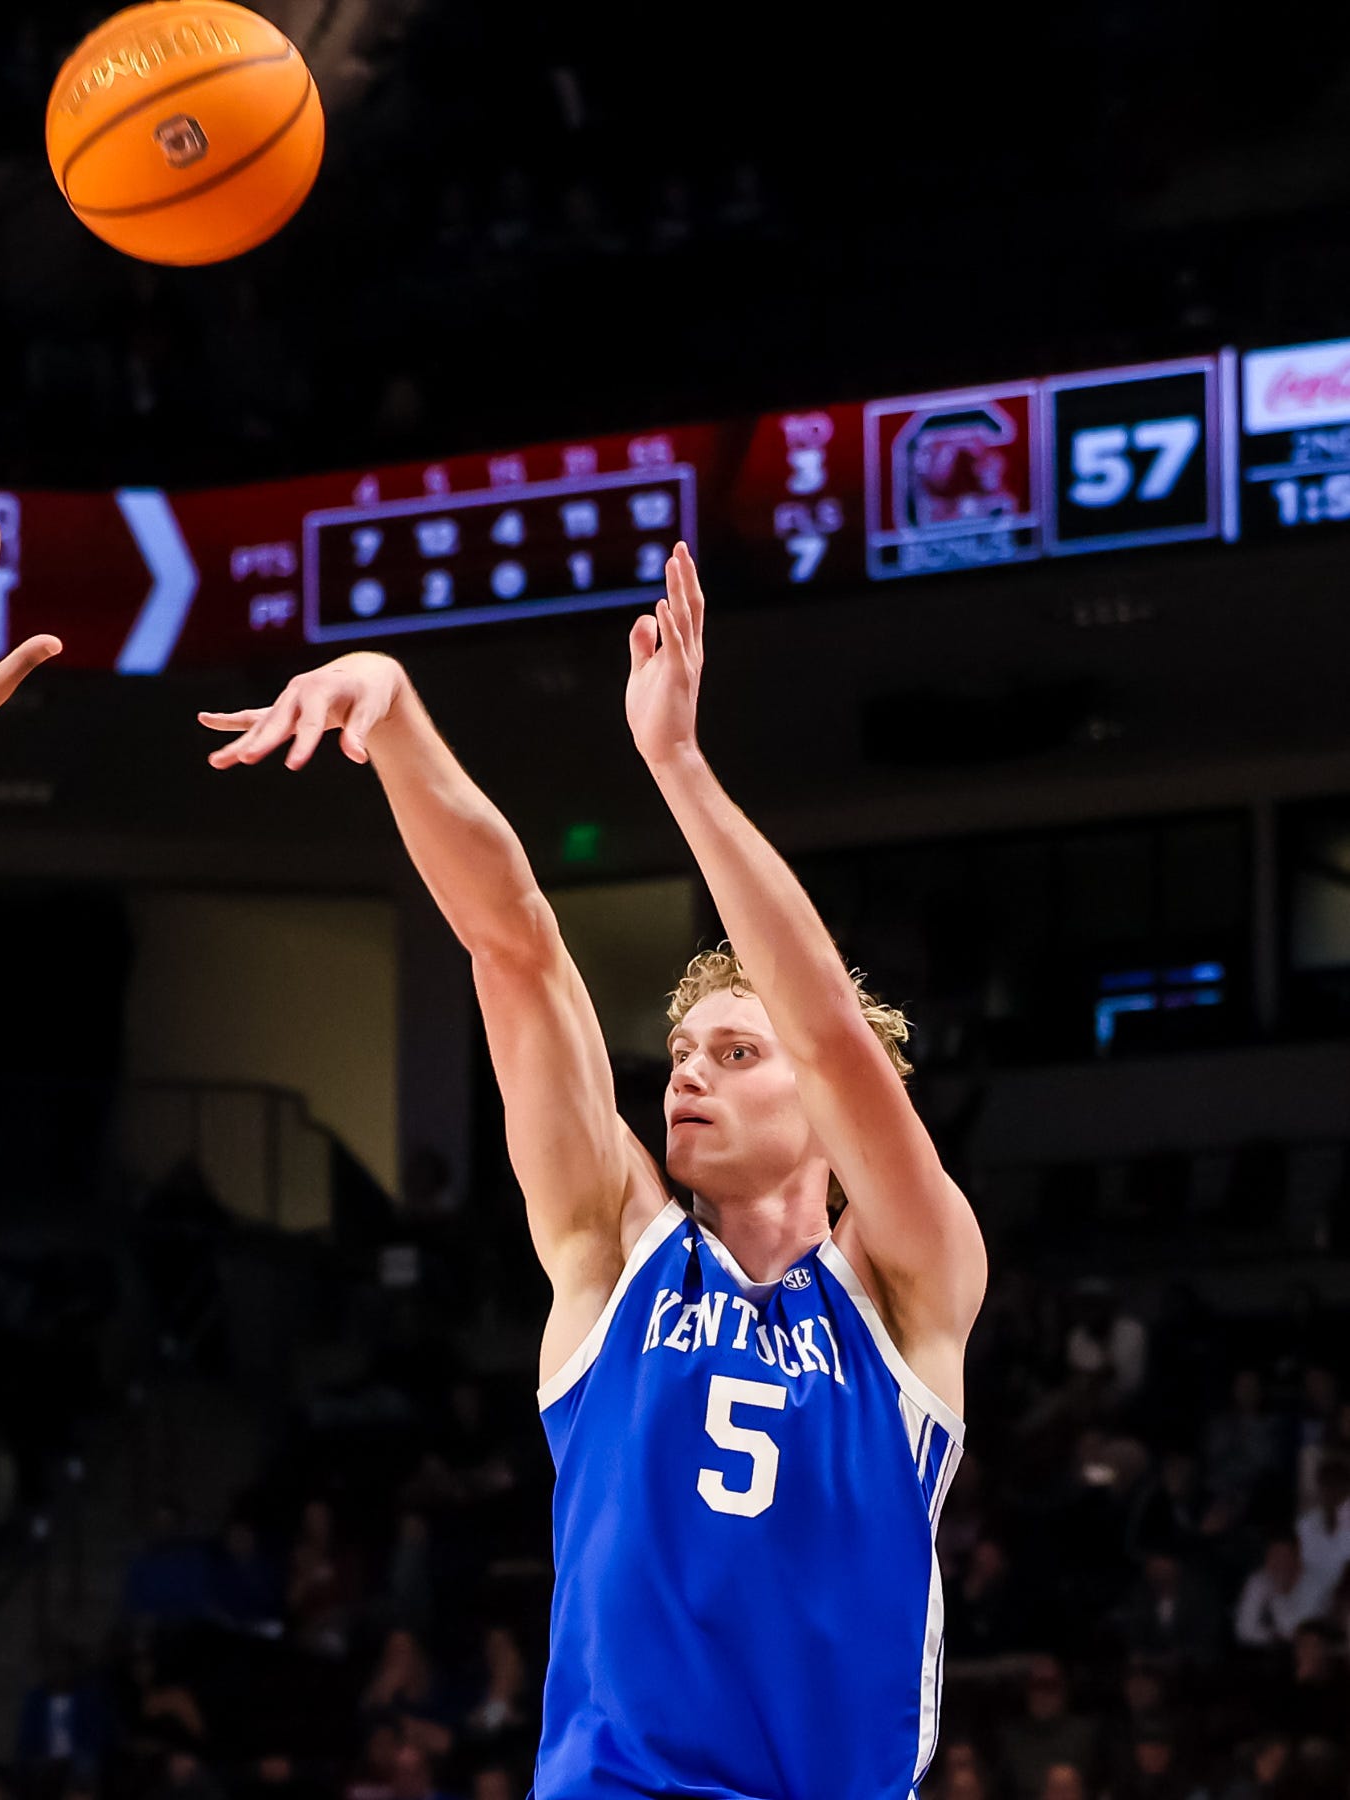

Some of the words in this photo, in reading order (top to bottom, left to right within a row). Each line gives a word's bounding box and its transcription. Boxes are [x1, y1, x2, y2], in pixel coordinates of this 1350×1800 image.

[788, 449, 826, 494] 3
[1069, 416, 1199, 508] 57
[352, 527, 383, 567] 7
[492, 509, 524, 545] 4
[788, 534, 827, 583] 7
[350, 578, 385, 617] 0
[491, 561, 526, 599] 0
[568, 552, 593, 590] 1
[697, 1375, 787, 1518] 5
